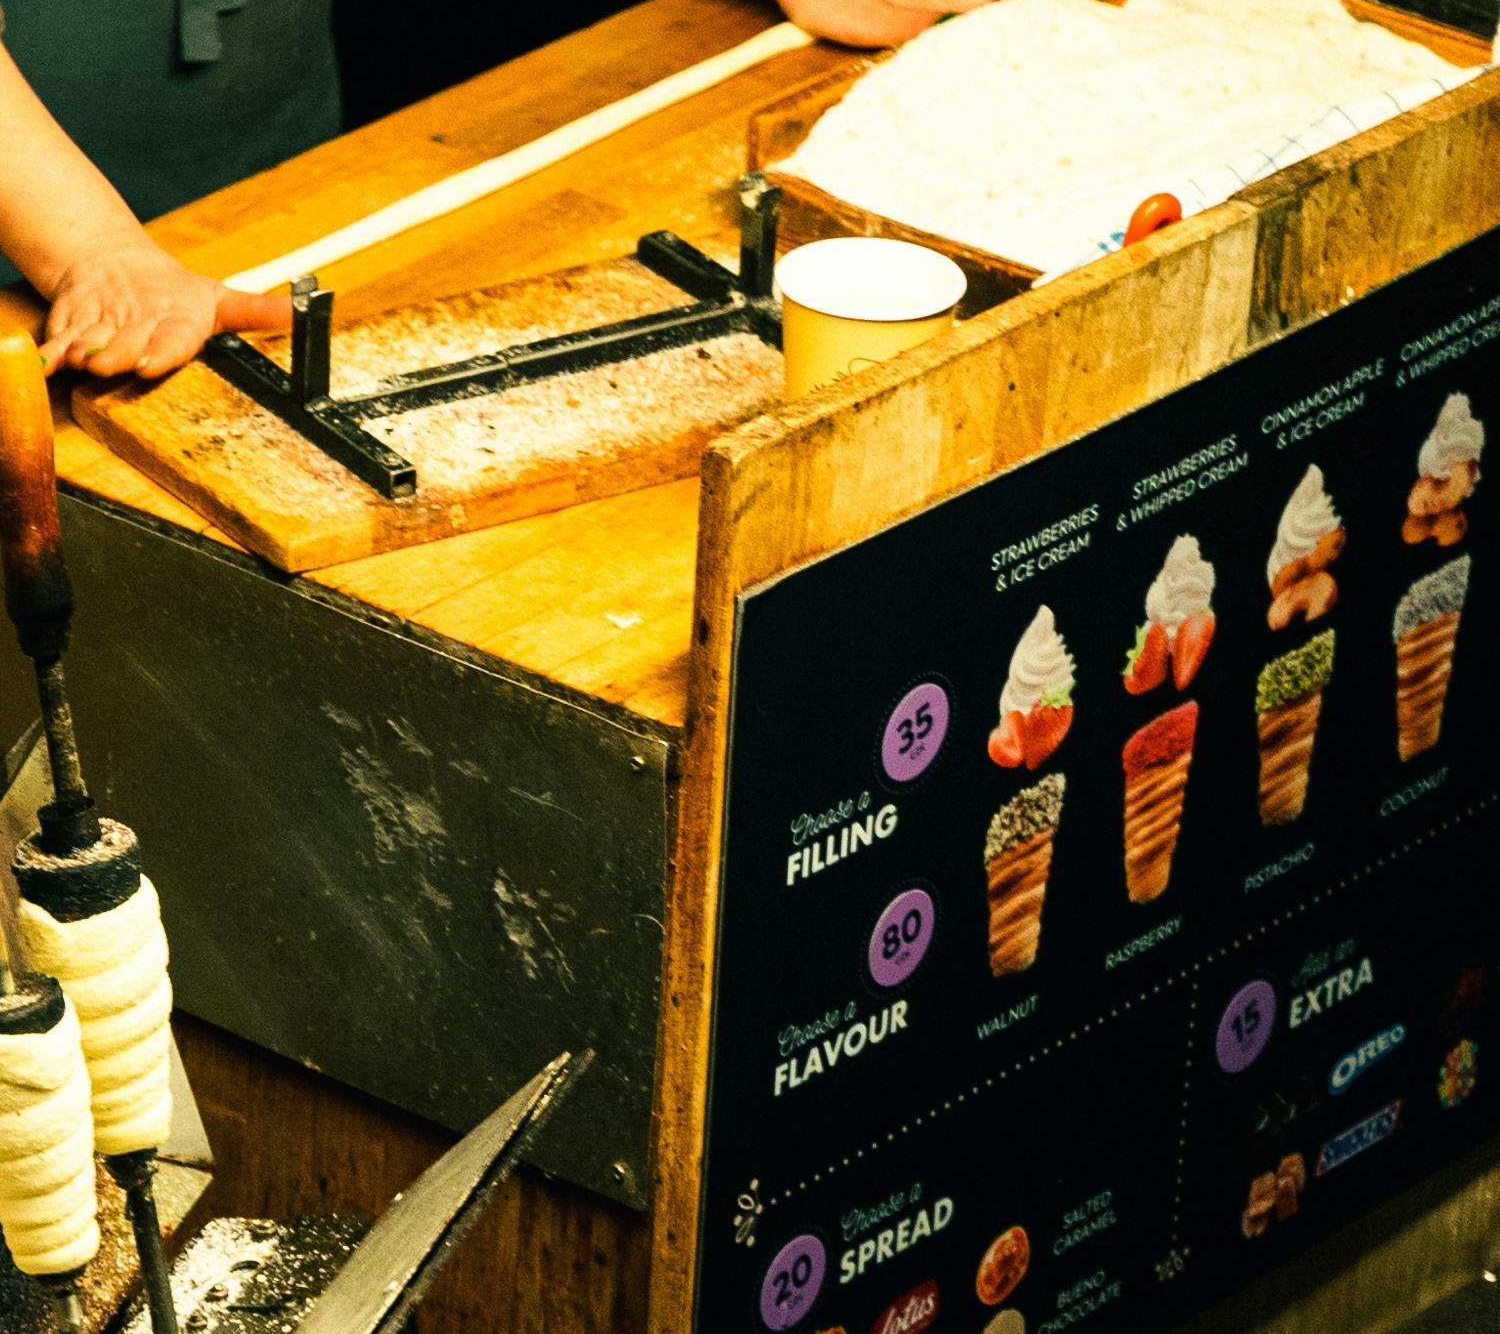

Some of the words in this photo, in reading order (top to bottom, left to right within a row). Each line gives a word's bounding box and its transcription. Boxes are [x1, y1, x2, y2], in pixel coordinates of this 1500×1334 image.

[1395, 369, 1407, 387] &
[1409, 335, 1471, 380] WHIPPED
[1400, 310, 1479, 362] CINNAMON
[1260, 381, 1345, 435] CINNAMON
[1343, 357, 1387, 393] APPLE
[1276, 432, 1288, 450] &
[1289, 417, 1314, 441] ICE
[1314, 391, 1366, 429] CREAM
[1115, 514, 1129, 532] &
[1129, 478, 1197, 524] WHIPPED
[1197, 451, 1249, 490] CREAM
[1130, 432, 1238, 501] STRAWBERRIES
[990, 503, 1101, 571] STRAWBERRIES
[995, 574, 1009, 593] &
[1010, 565, 1036, 586] ICE
[1036, 532, 1093, 572] CREAM
[896, 702, 933, 755] 35
[790, 798, 855, 847] Choose
[857, 790, 872, 812] a
[1378, 766, 1450, 817] COCONUT
[785, 803, 899, 887] FILLING
[1243, 840, 1316, 894] PISTACHIO
[882, 908, 922, 960] 80
[1104, 914, 1185, 971] RASPBERRY
[975, 993, 1040, 1041] WALNUT
[1230, 998, 1261, 1044] 15
[1288, 956, 1375, 1029] EXTRA
[773, 999, 909, 1098] FLAVOUR
[777, 1009, 841, 1058] Choose
[1330, 1024, 1407, 1089] OREO
[839, 1195, 955, 1285] SPREAD
[1053, 1209, 1118, 1256] CARAMEL
[772, 1253, 812, 1307] 20
